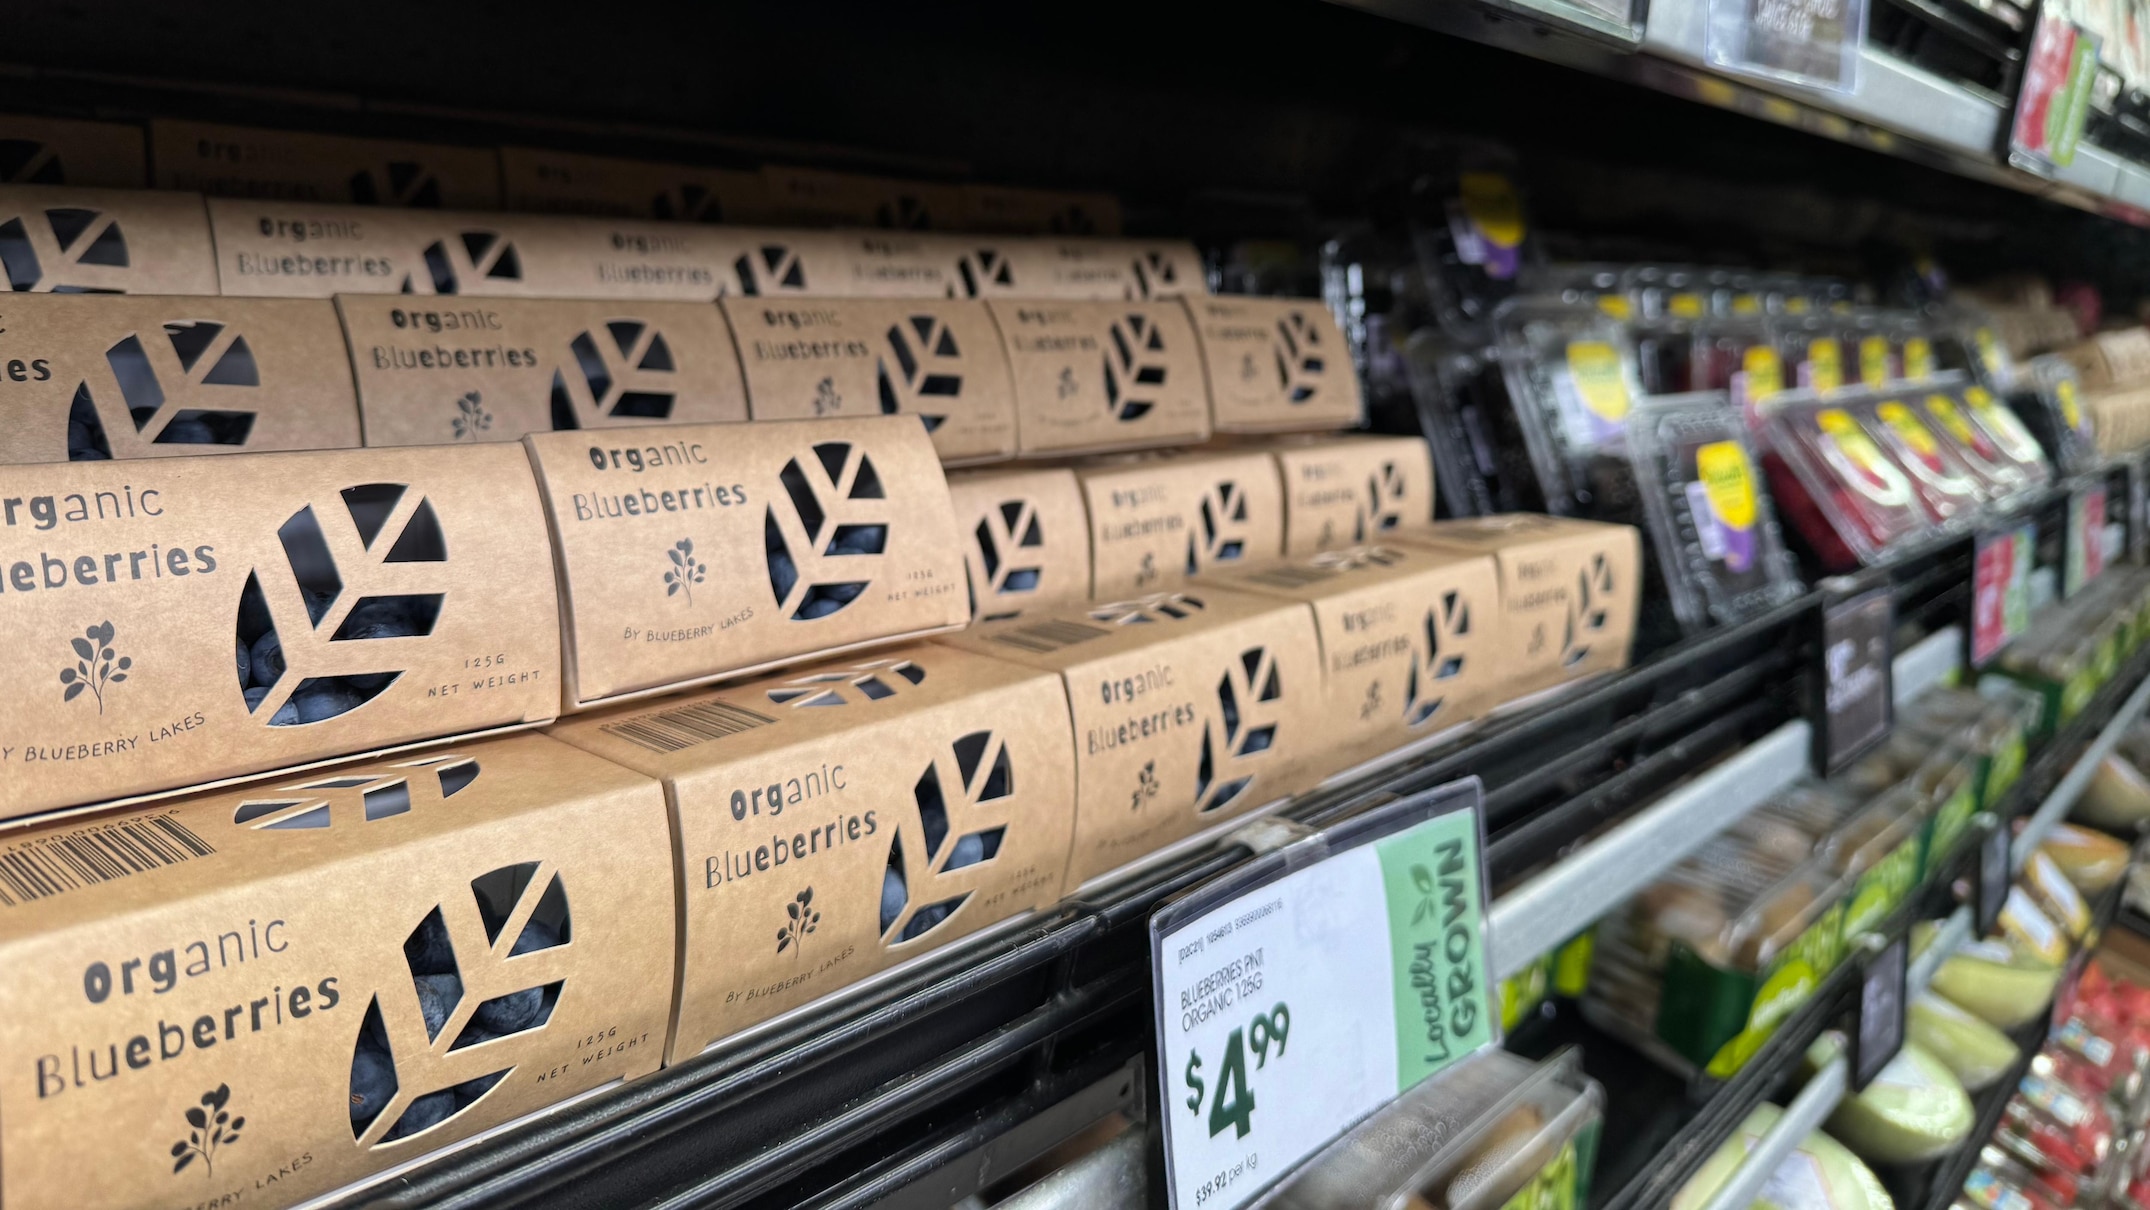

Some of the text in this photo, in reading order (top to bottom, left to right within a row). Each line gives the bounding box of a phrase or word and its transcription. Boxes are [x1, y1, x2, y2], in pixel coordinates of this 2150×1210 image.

[259, 217, 364, 242] Organic
[238, 252, 392, 276] Blueberries
[391, 308, 503, 333] Organic
[0, 358, 52, 382] es
[373, 343, 538, 370] Blueberries
[589, 441, 708, 473] Organic
[3, 485, 165, 531] rganic
[573, 482, 748, 521] Blueberries
[624, 606, 754, 642] BY BLUEBERRY LAKES
[427, 670, 540, 697] NET WEIGHT
[464, 653, 505, 669] 125G
[1101, 664, 1174, 704] Organic
[25, 735, 139, 762] BLUEBERRY
[150, 711, 206, 743] LAKES
[1087, 702, 1195, 755] Blueberries
[730, 763, 847, 821] Organic
[705, 809, 878, 889] Blueberries
[1433, 836, 1478, 1039] GROWN
[82, 917, 290, 1005] Organic
[725, 944, 855, 1003] BY BLUEBERRY LAKES
[1180, 957, 1244, 1011] BLUEBERRIES
[1182, 970, 1263, 1033] ORGANIC 125G
[1408, 939, 1450, 1064] Locally
[35, 976, 341, 1100] Blueberries
[536, 1032, 649, 1083] NET WEIGHT
[576, 1026, 617, 1049] 125G
[255, 1152, 314, 1190] LAKES
[1195, 1152, 1258, 1207] $39.92 per kg
